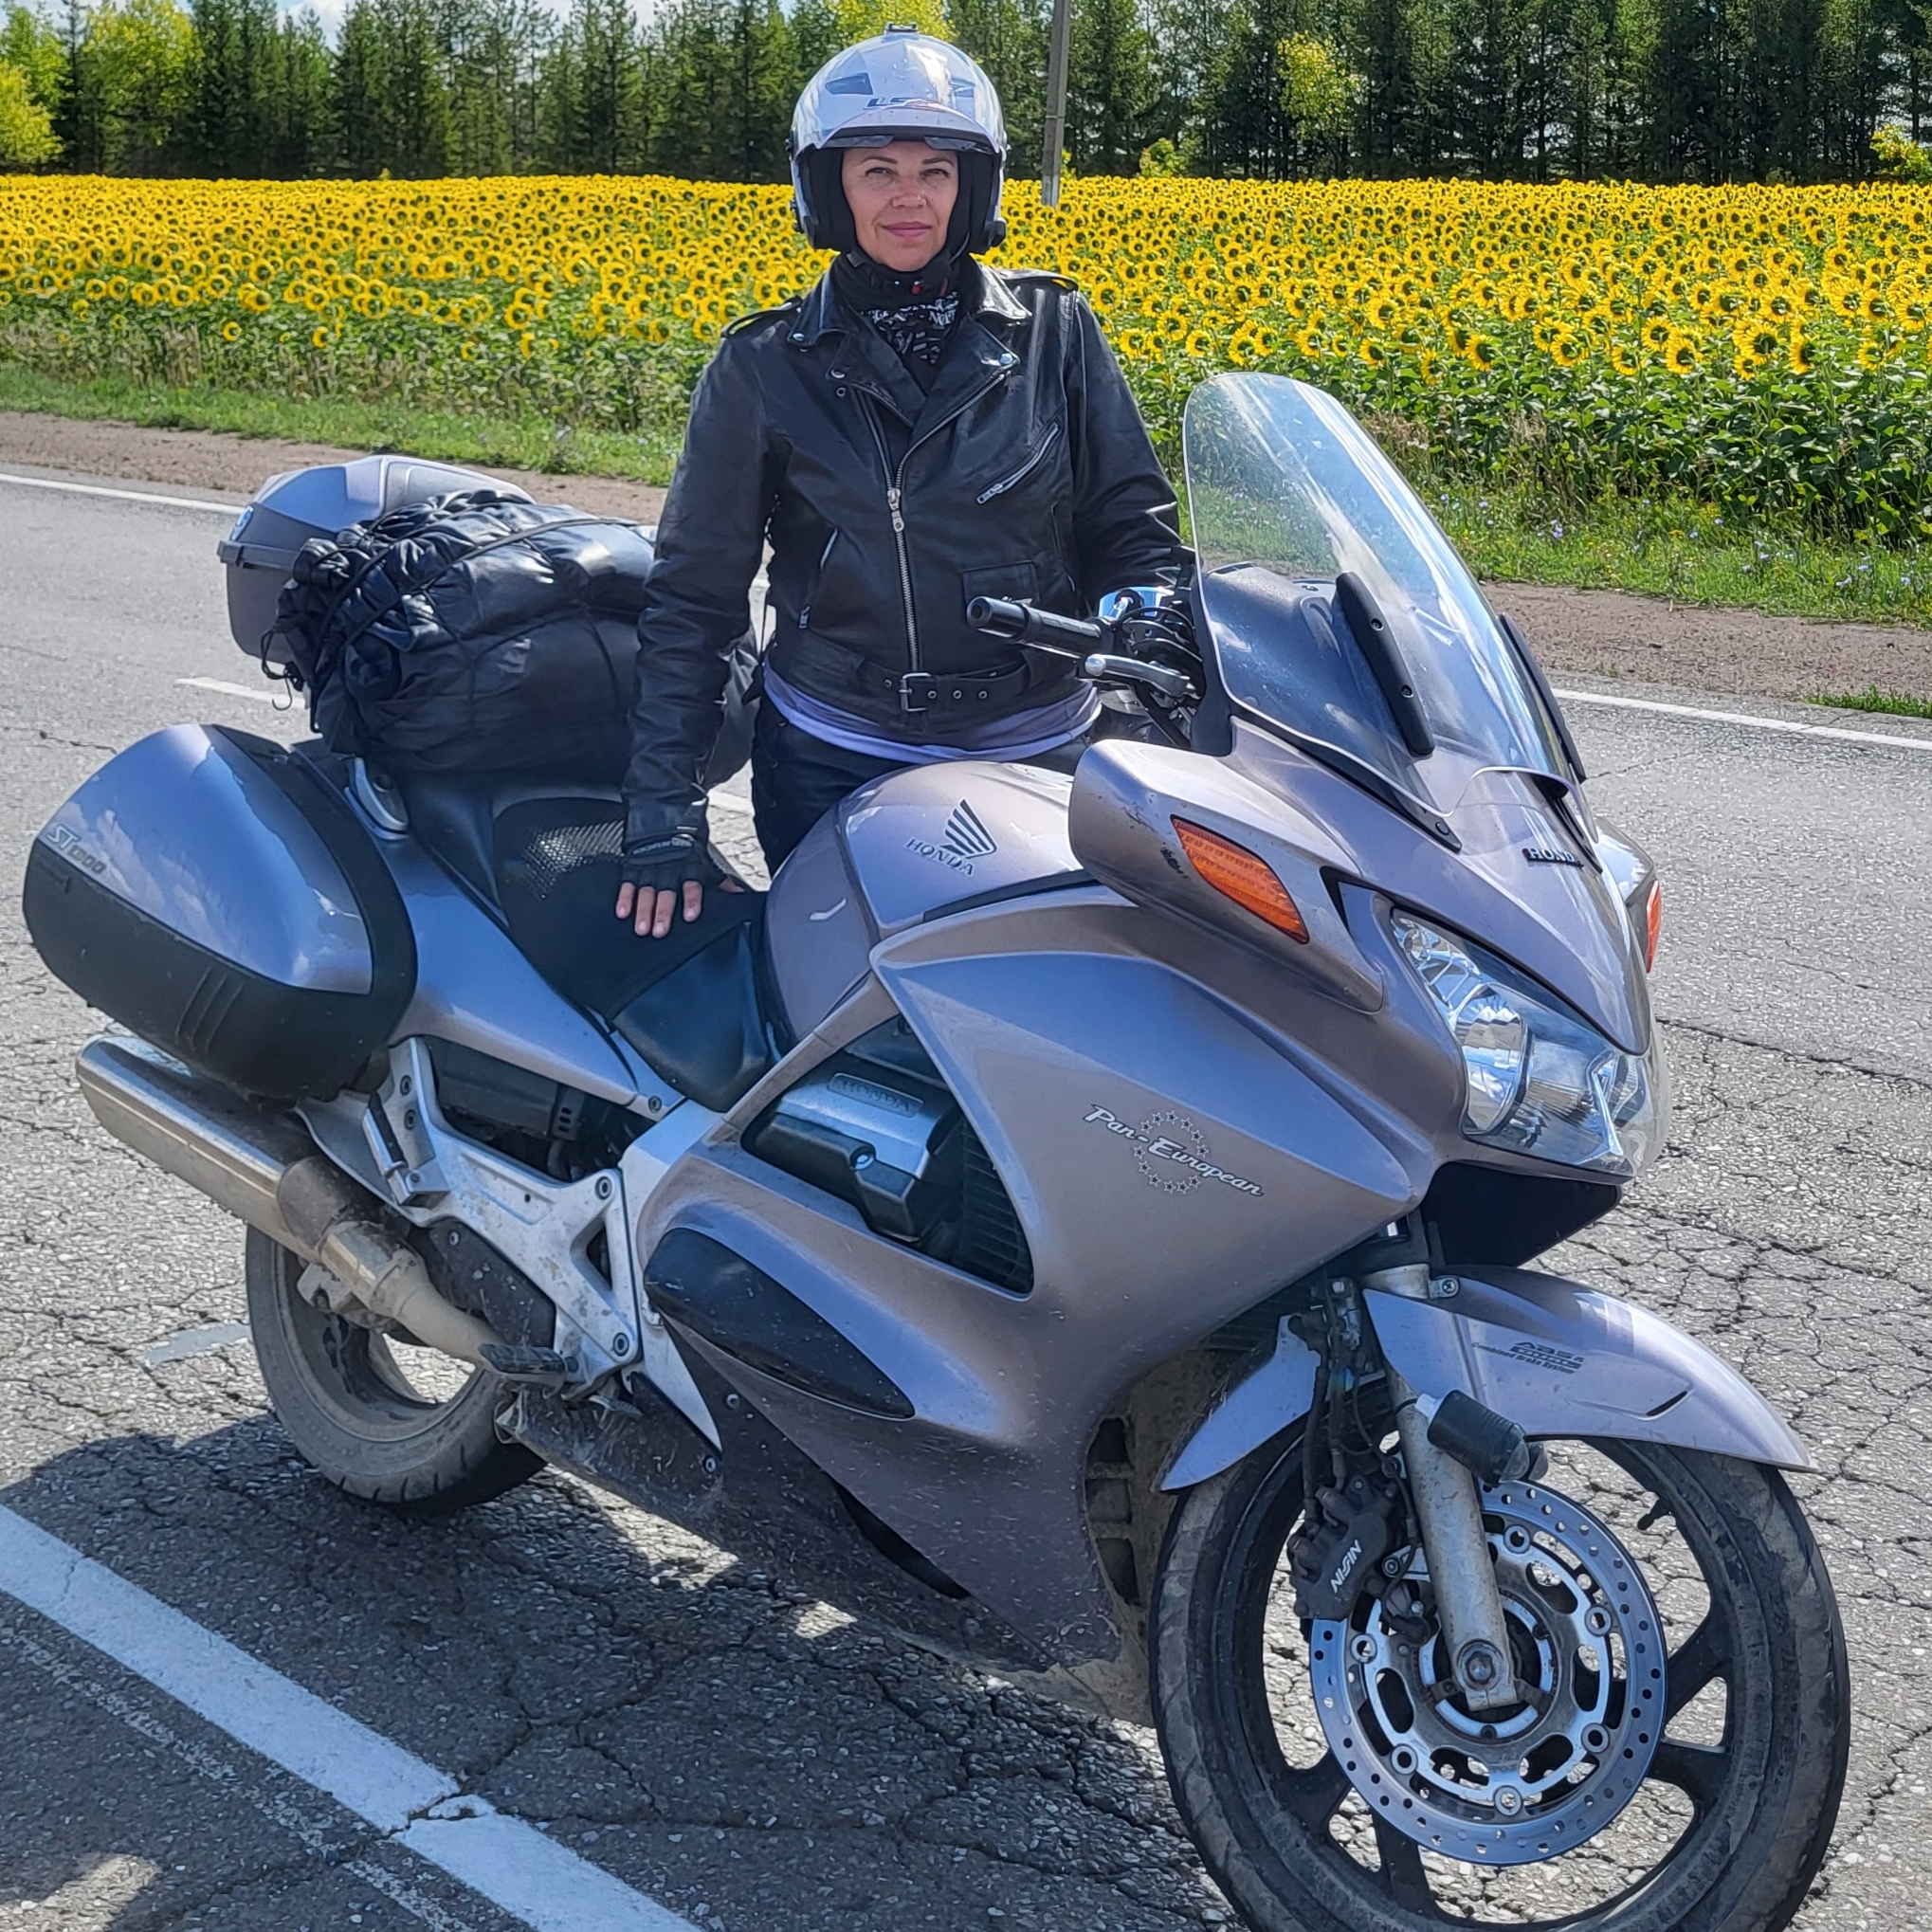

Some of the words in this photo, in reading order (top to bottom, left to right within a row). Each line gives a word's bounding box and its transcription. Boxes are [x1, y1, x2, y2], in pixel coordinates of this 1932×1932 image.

[905, 838, 974, 876] HONDA
[842, 1080, 910, 1112] HONDA
[1515, 1354, 1542, 1366] Brake
[1541, 1361, 1576, 1375] System
